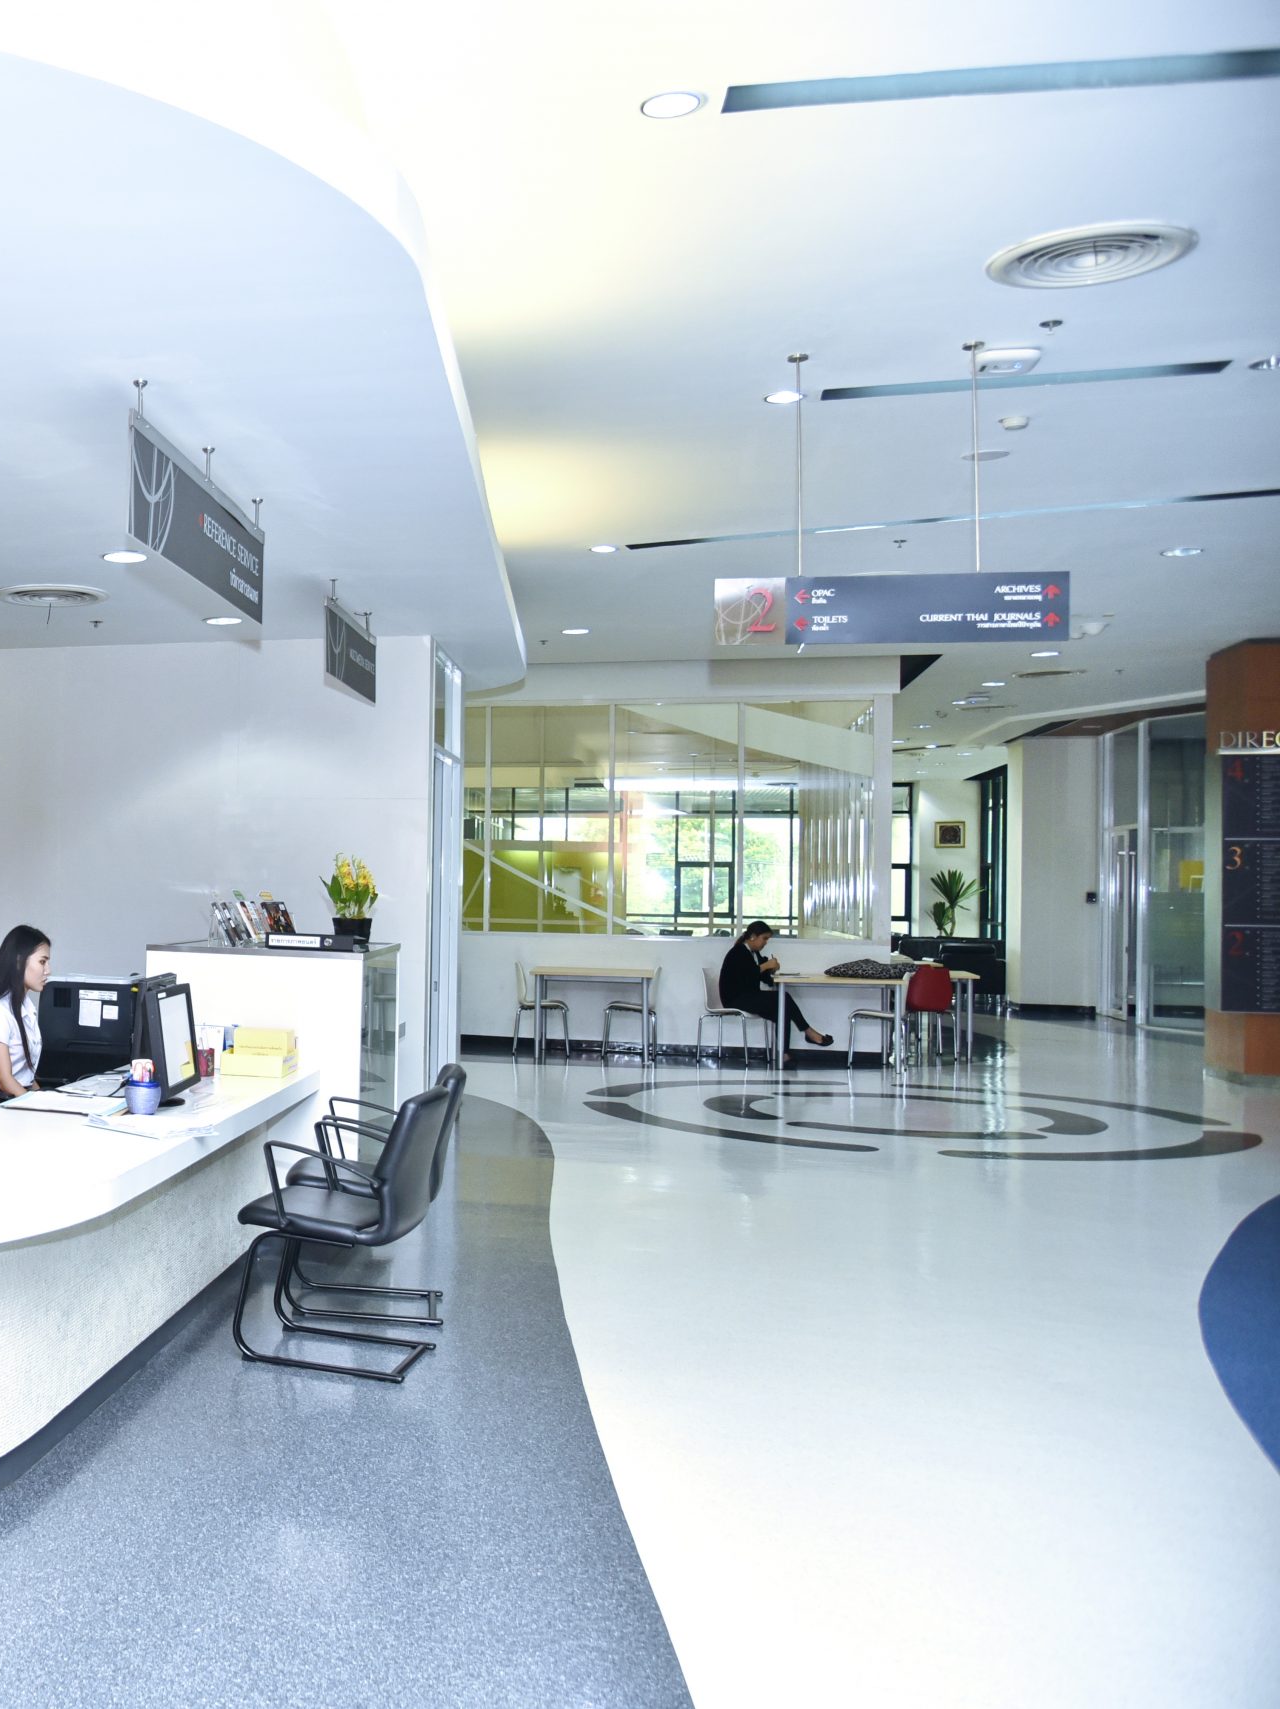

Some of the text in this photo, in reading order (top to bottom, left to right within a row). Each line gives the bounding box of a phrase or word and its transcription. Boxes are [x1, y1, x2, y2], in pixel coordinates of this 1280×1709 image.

[203, 513, 259, 577] REFERENCE SERVICE
[811, 588, 836, 598] OPAC
[993, 584, 1042, 594] ARCHIVES
[746, 587, 776, 632] 2
[919, 611, 1042, 623] CURRENT THAI JOURNALS
[811, 615, 849, 625] TOILETS
[1220, 730, 1280, 749] DIRE
[1225, 845, 1243, 871] 3
